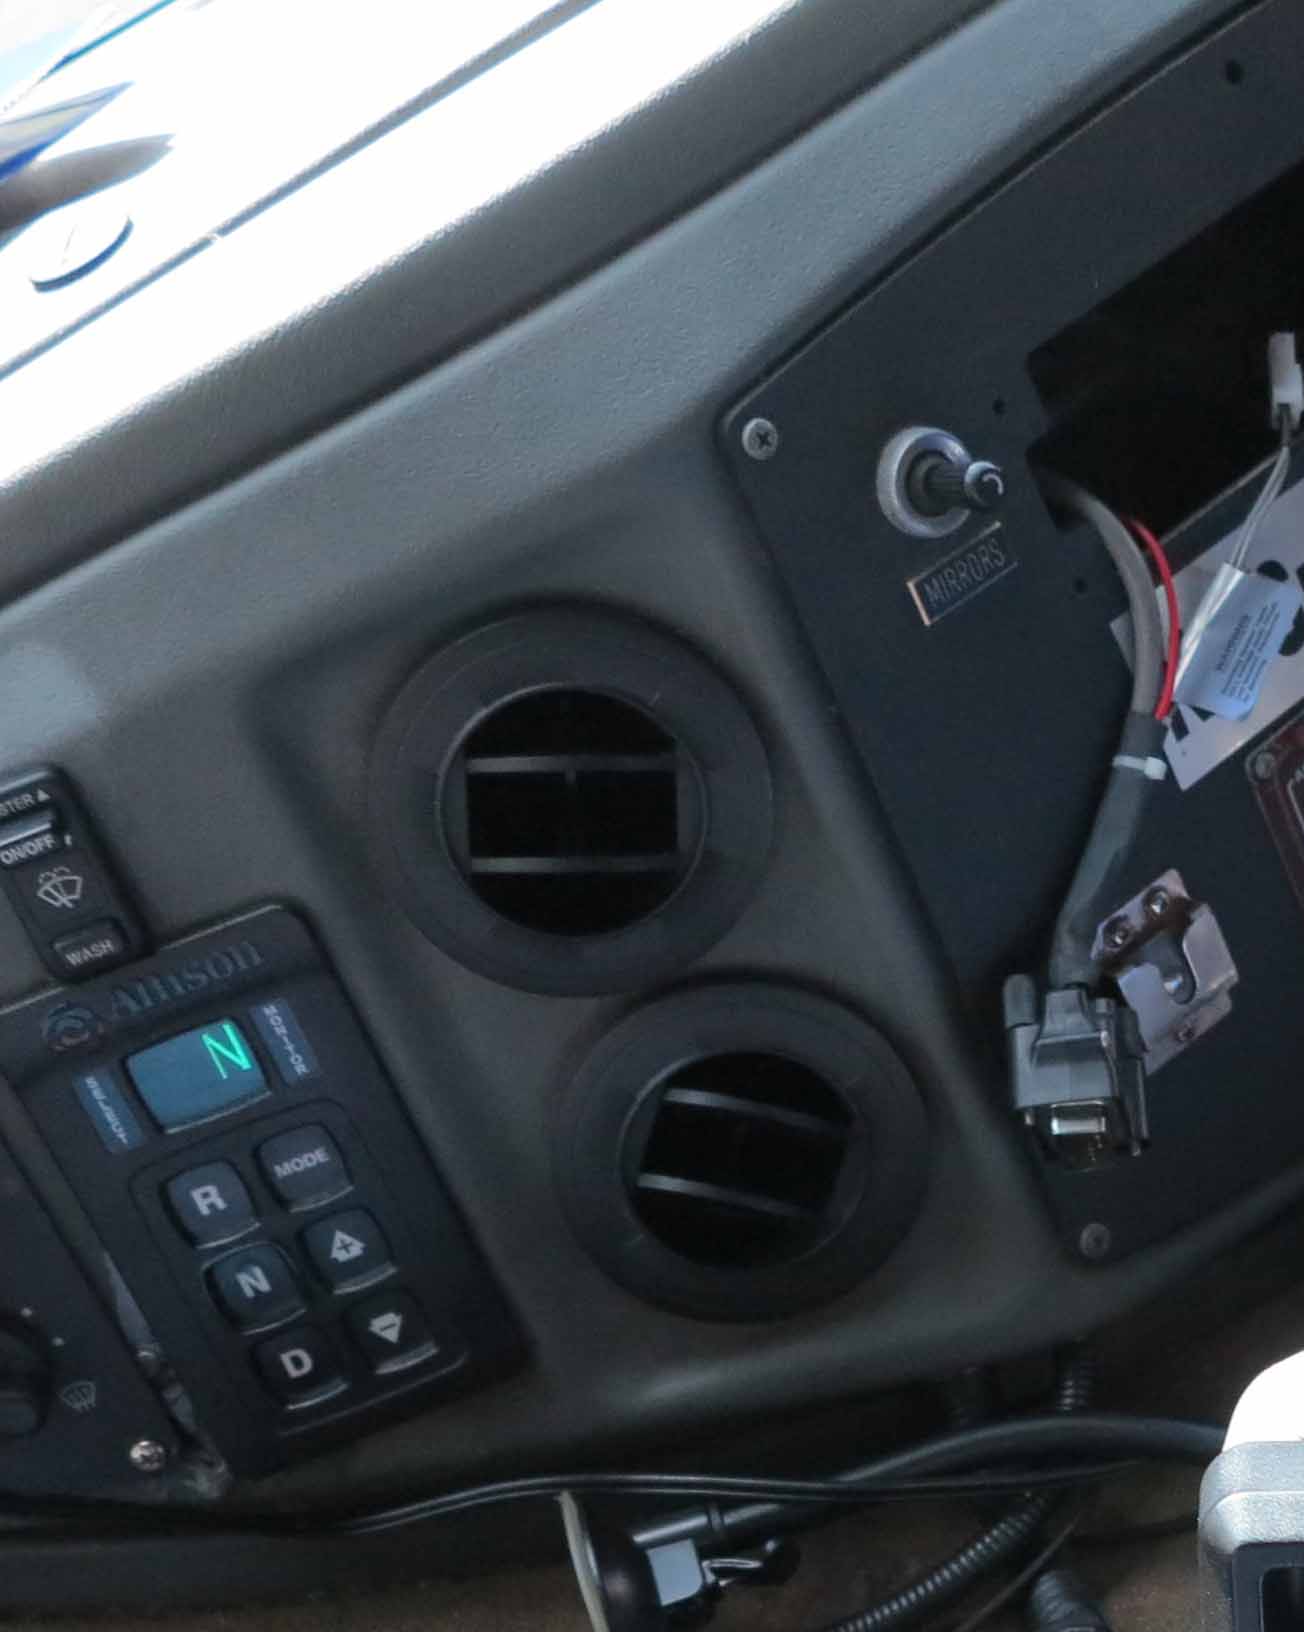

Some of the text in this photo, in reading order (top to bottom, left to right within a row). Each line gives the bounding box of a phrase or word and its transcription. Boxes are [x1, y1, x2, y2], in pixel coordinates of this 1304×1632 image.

[922, 537, 1006, 604] MIRRORS
[64, 936, 116, 968] WASH
[110, 939, 266, 1018] Allison
[200, 1017, 253, 1082] N
[272, 1144, 331, 1180] MODE
[191, 1183, 229, 1217] R
[234, 1263, 273, 1301] N
[279, 1347, 315, 1380] D
